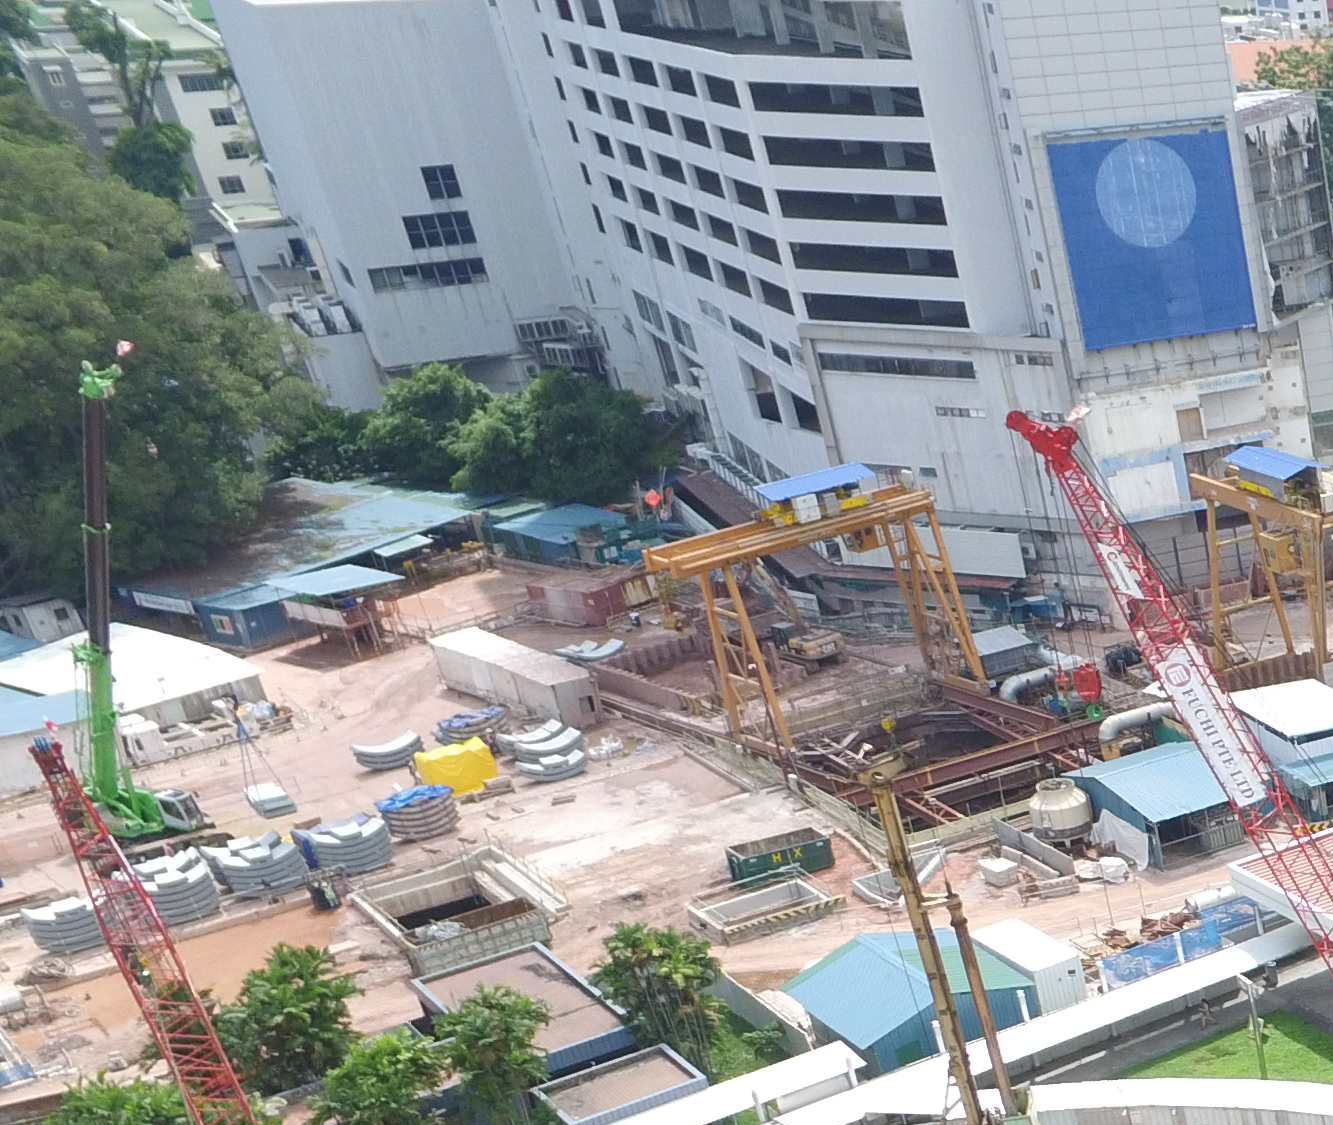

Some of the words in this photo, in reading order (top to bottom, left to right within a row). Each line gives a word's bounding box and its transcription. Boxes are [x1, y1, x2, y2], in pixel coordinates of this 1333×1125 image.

[1182, 688, 1219, 738] FUCHI
[1211, 739, 1235, 769] PTE
[1230, 770, 1255, 799] LTD
